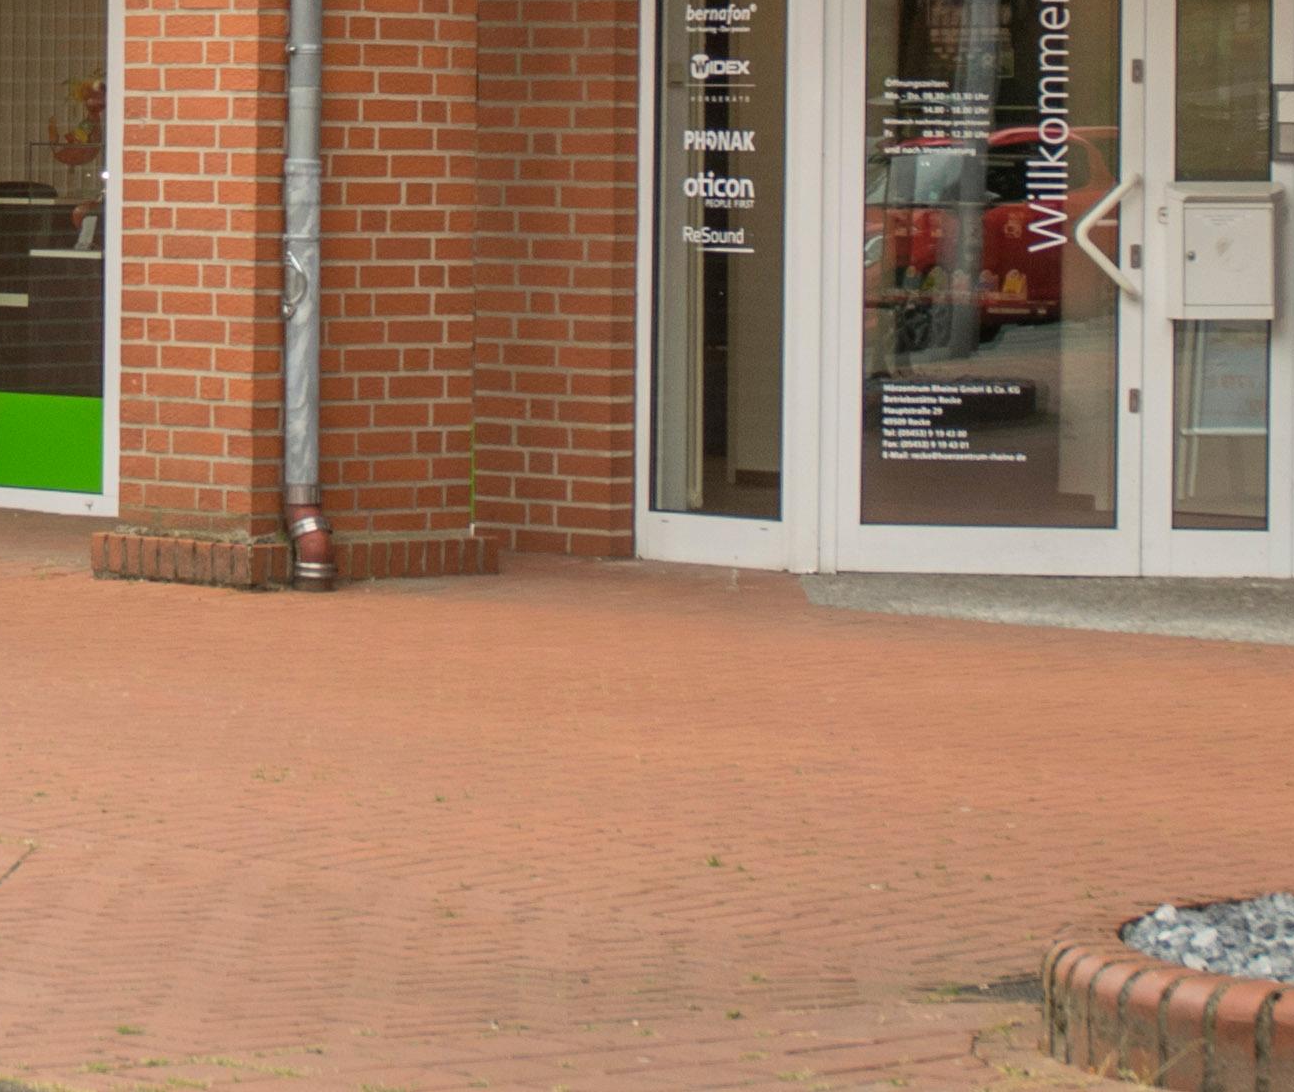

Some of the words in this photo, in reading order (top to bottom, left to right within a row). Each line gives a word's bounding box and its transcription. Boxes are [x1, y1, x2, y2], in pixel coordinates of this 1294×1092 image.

[690, 54, 750, 80] WIDEX
[684, 130, 756, 152] PHONAK
[683, 170, 756, 199] oticon
[682, 225, 745, 245] ReSound
